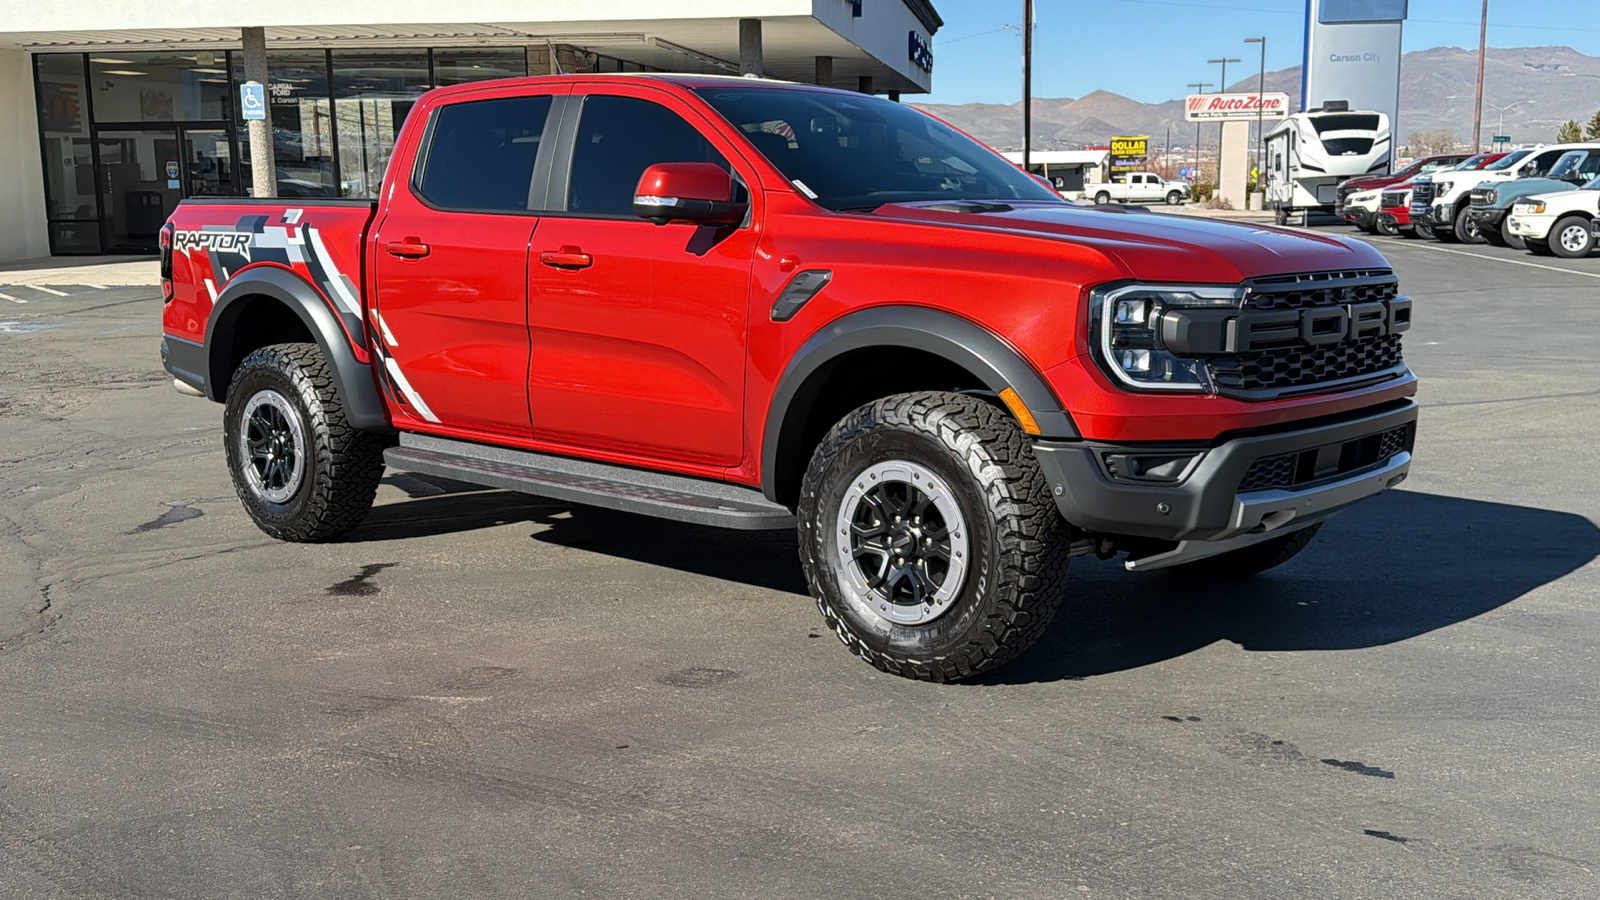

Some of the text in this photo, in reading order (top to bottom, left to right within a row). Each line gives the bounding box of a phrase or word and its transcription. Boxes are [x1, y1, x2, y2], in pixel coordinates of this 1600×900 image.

[1329, 52, 1381, 63] Carson City
[1208, 96, 1280, 110] AutoZone
[1111, 141, 1146, 150] DOLLAR
[174, 231, 252, 263] RAPTOR
[1226, 299, 1413, 353] FORD
